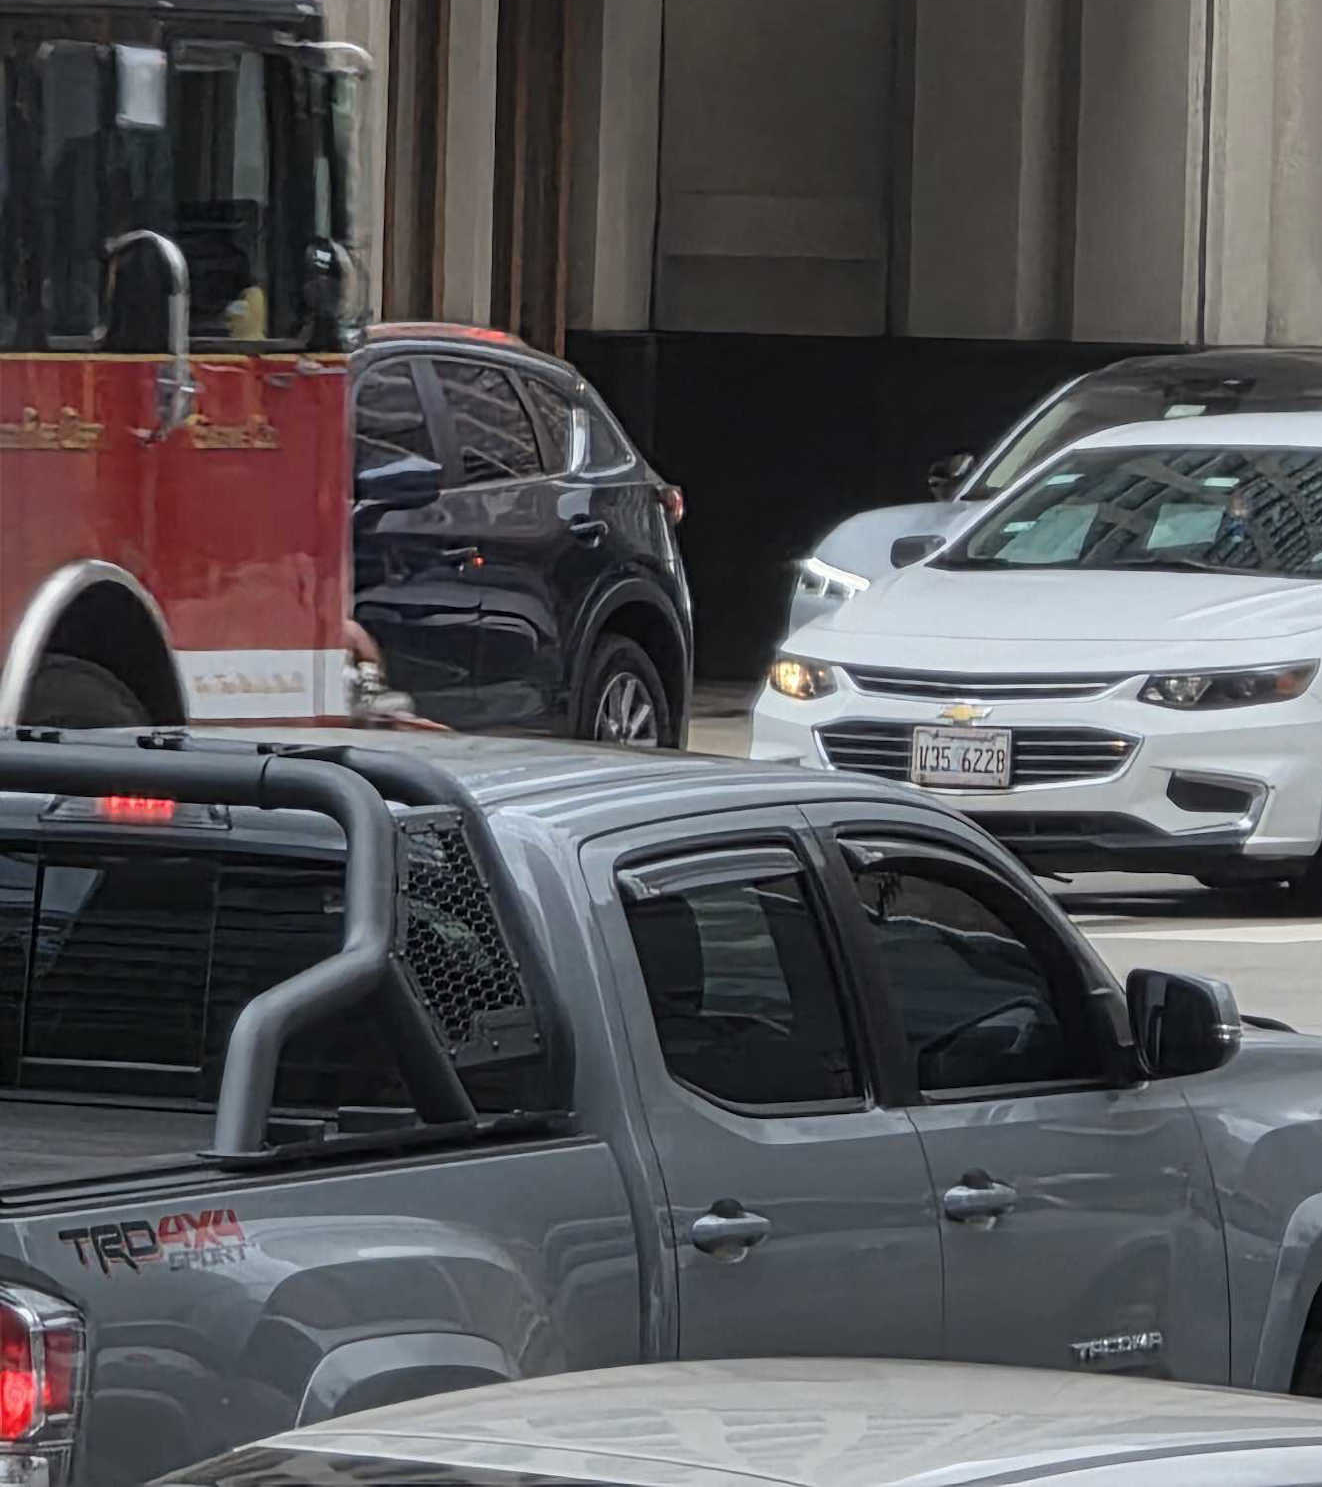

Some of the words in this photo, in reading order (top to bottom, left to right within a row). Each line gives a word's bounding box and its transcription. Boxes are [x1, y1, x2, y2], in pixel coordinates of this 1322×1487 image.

[961, 748, 1005, 773] 6228
[59, 1220, 162, 1279] TRD
[169, 1244, 247, 1272] SPORT
